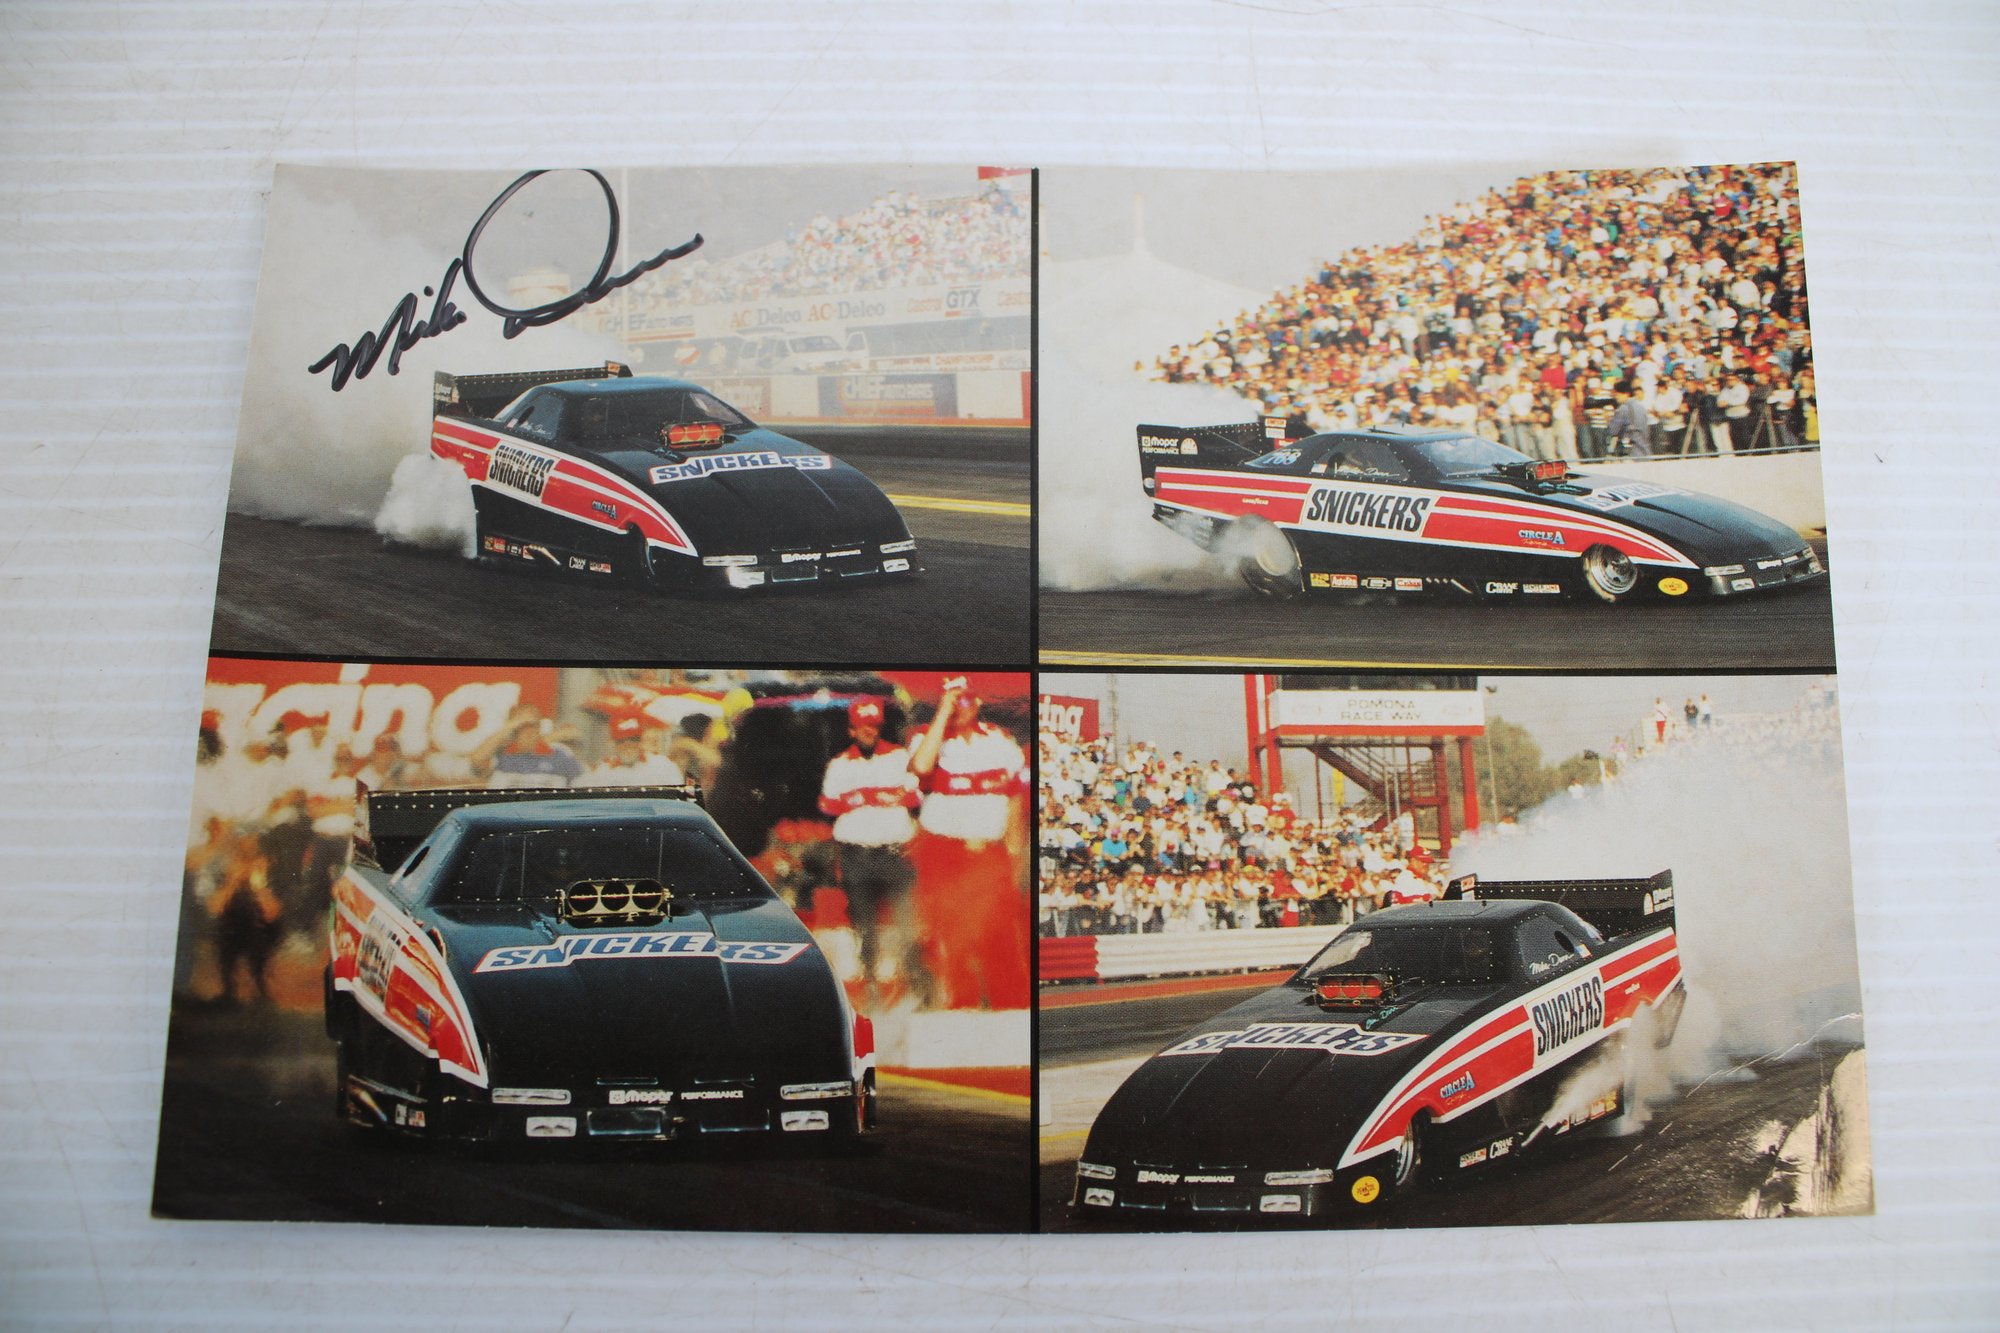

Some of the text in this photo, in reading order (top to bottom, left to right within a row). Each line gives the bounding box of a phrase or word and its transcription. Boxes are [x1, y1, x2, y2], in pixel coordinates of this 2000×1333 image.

[945, 290, 981, 308] GTX
[489, 444, 556, 497] SNICKERS
[655, 453, 826, 481] SNICKERS
[1307, 488, 1430, 532] SNICKERS
[1518, 529, 1554, 542] CIRCLE
[1341, 711, 1383, 721] RACE
[1347, 699, 1416, 709] POMONA
[1039, 695, 1084, 741] ing
[491, 934, 798, 968] SNICKERS
[1531, 975, 1604, 1056] SNICKERS
[1178, 1025, 1410, 1052] SNICKERS
[681, 1090, 744, 1100] PERFORMANCE
